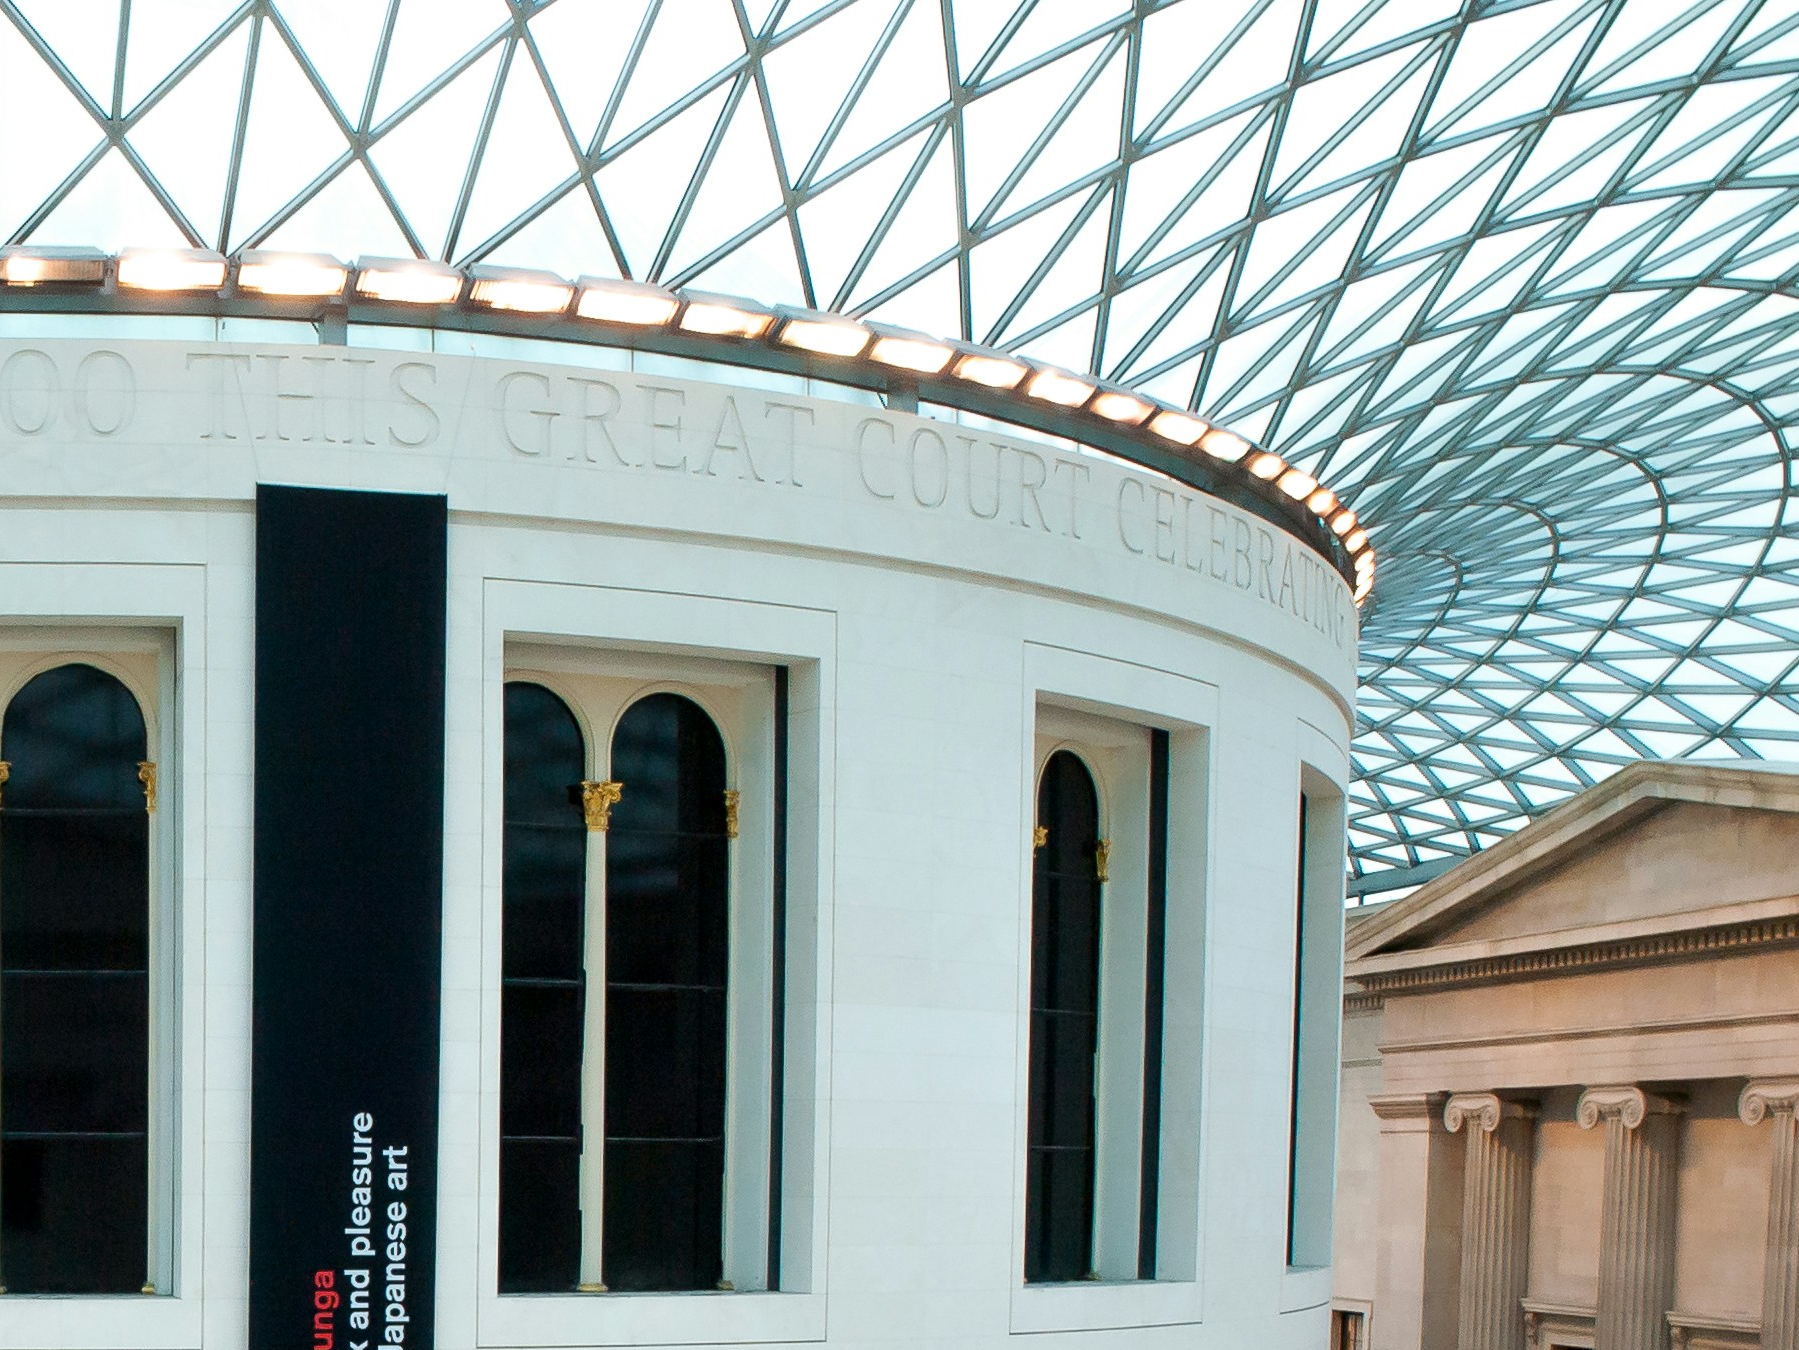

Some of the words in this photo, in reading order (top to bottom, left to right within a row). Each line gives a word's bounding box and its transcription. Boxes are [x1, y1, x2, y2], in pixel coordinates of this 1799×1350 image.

[185, 353, 441, 448] THIS
[496, 370, 816, 488] GREAT
[856, 417, 1091, 540] COURT
[1116, 476, 1345, 650] CELEBRATING
[345, 1112, 376, 1256] pleasure
[383, 1145, 407, 1190] art
[344, 1269, 370, 1329] and
